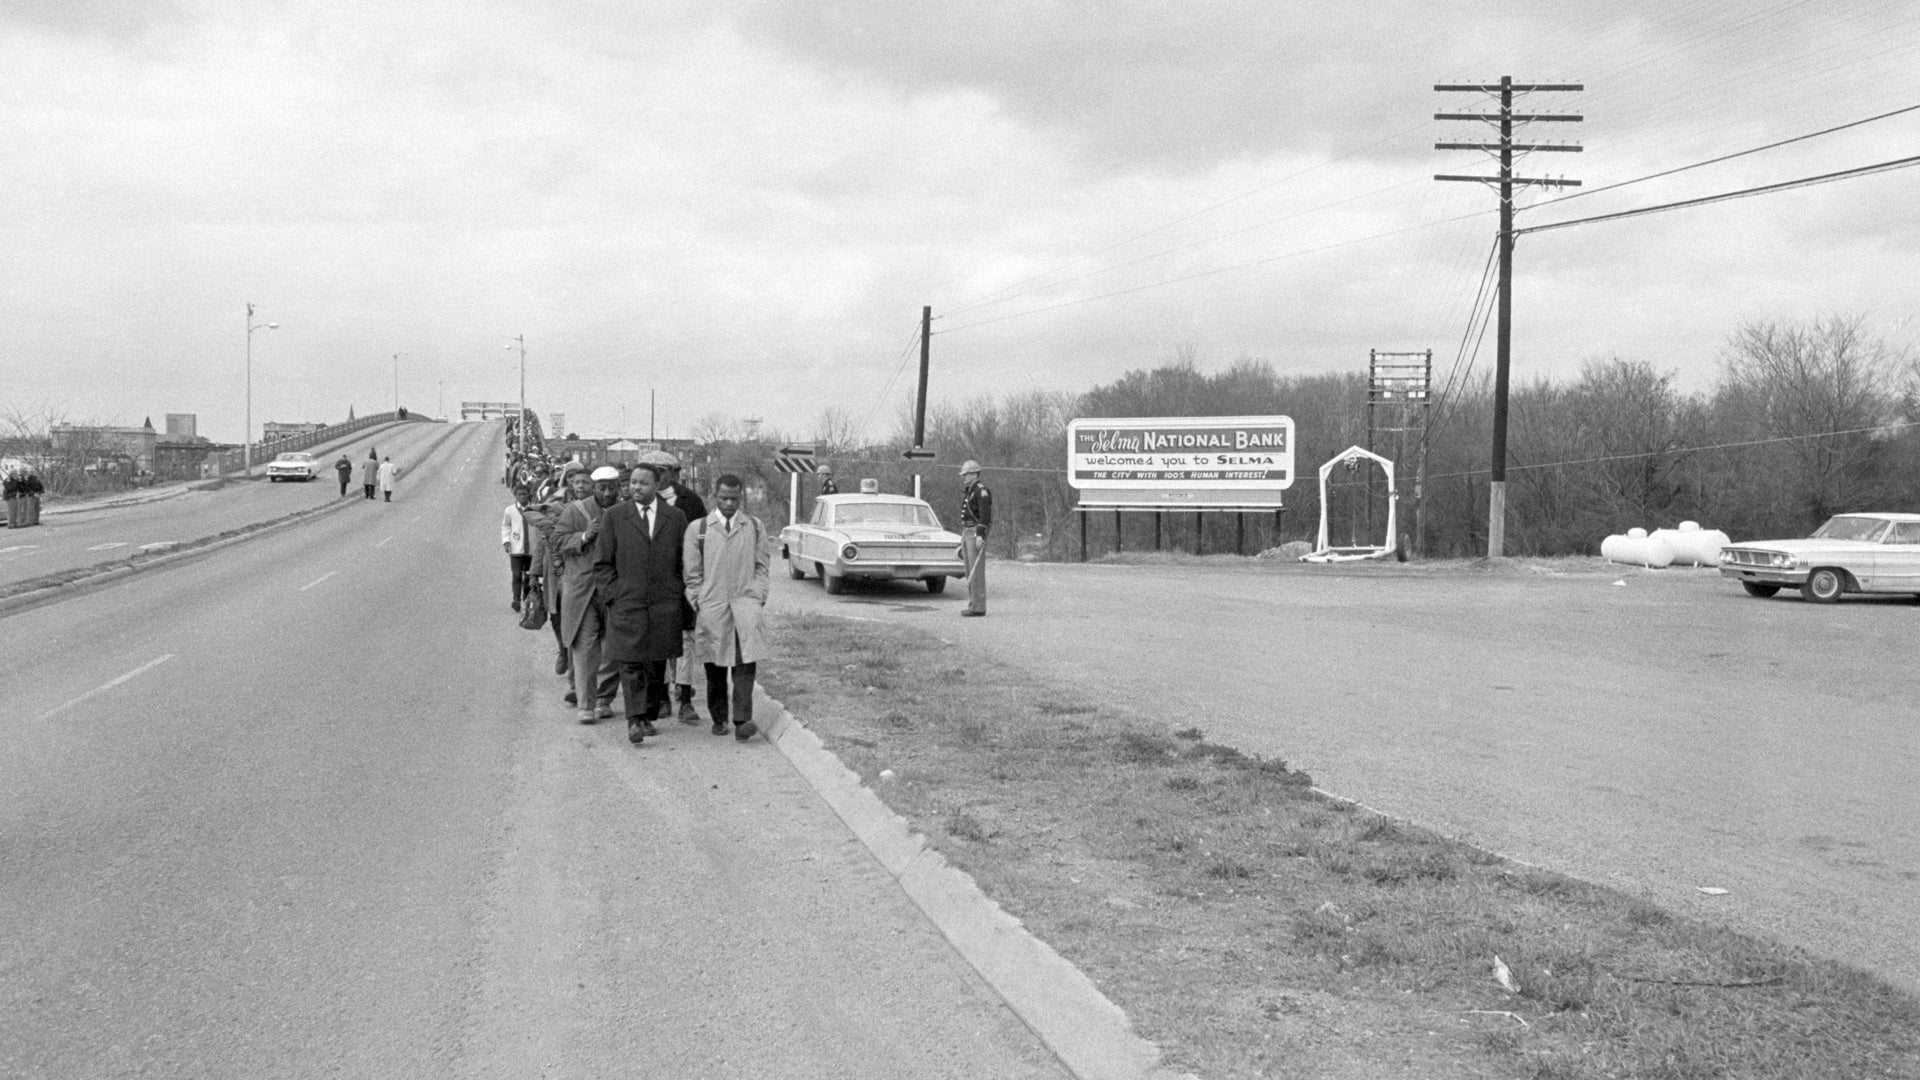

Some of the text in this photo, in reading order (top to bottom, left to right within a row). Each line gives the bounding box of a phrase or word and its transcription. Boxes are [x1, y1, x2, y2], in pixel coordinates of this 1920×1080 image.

[1091, 430, 1139, 454] Selma
[1144, 432, 1231, 451] NATIONAL
[1235, 431, 1284, 450] BANK
[1086, 455, 1274, 468] welcomes you to SELMA
[1093, 468, 1269, 479] THE CITY WITH 100% HUMAN INTEREST!
